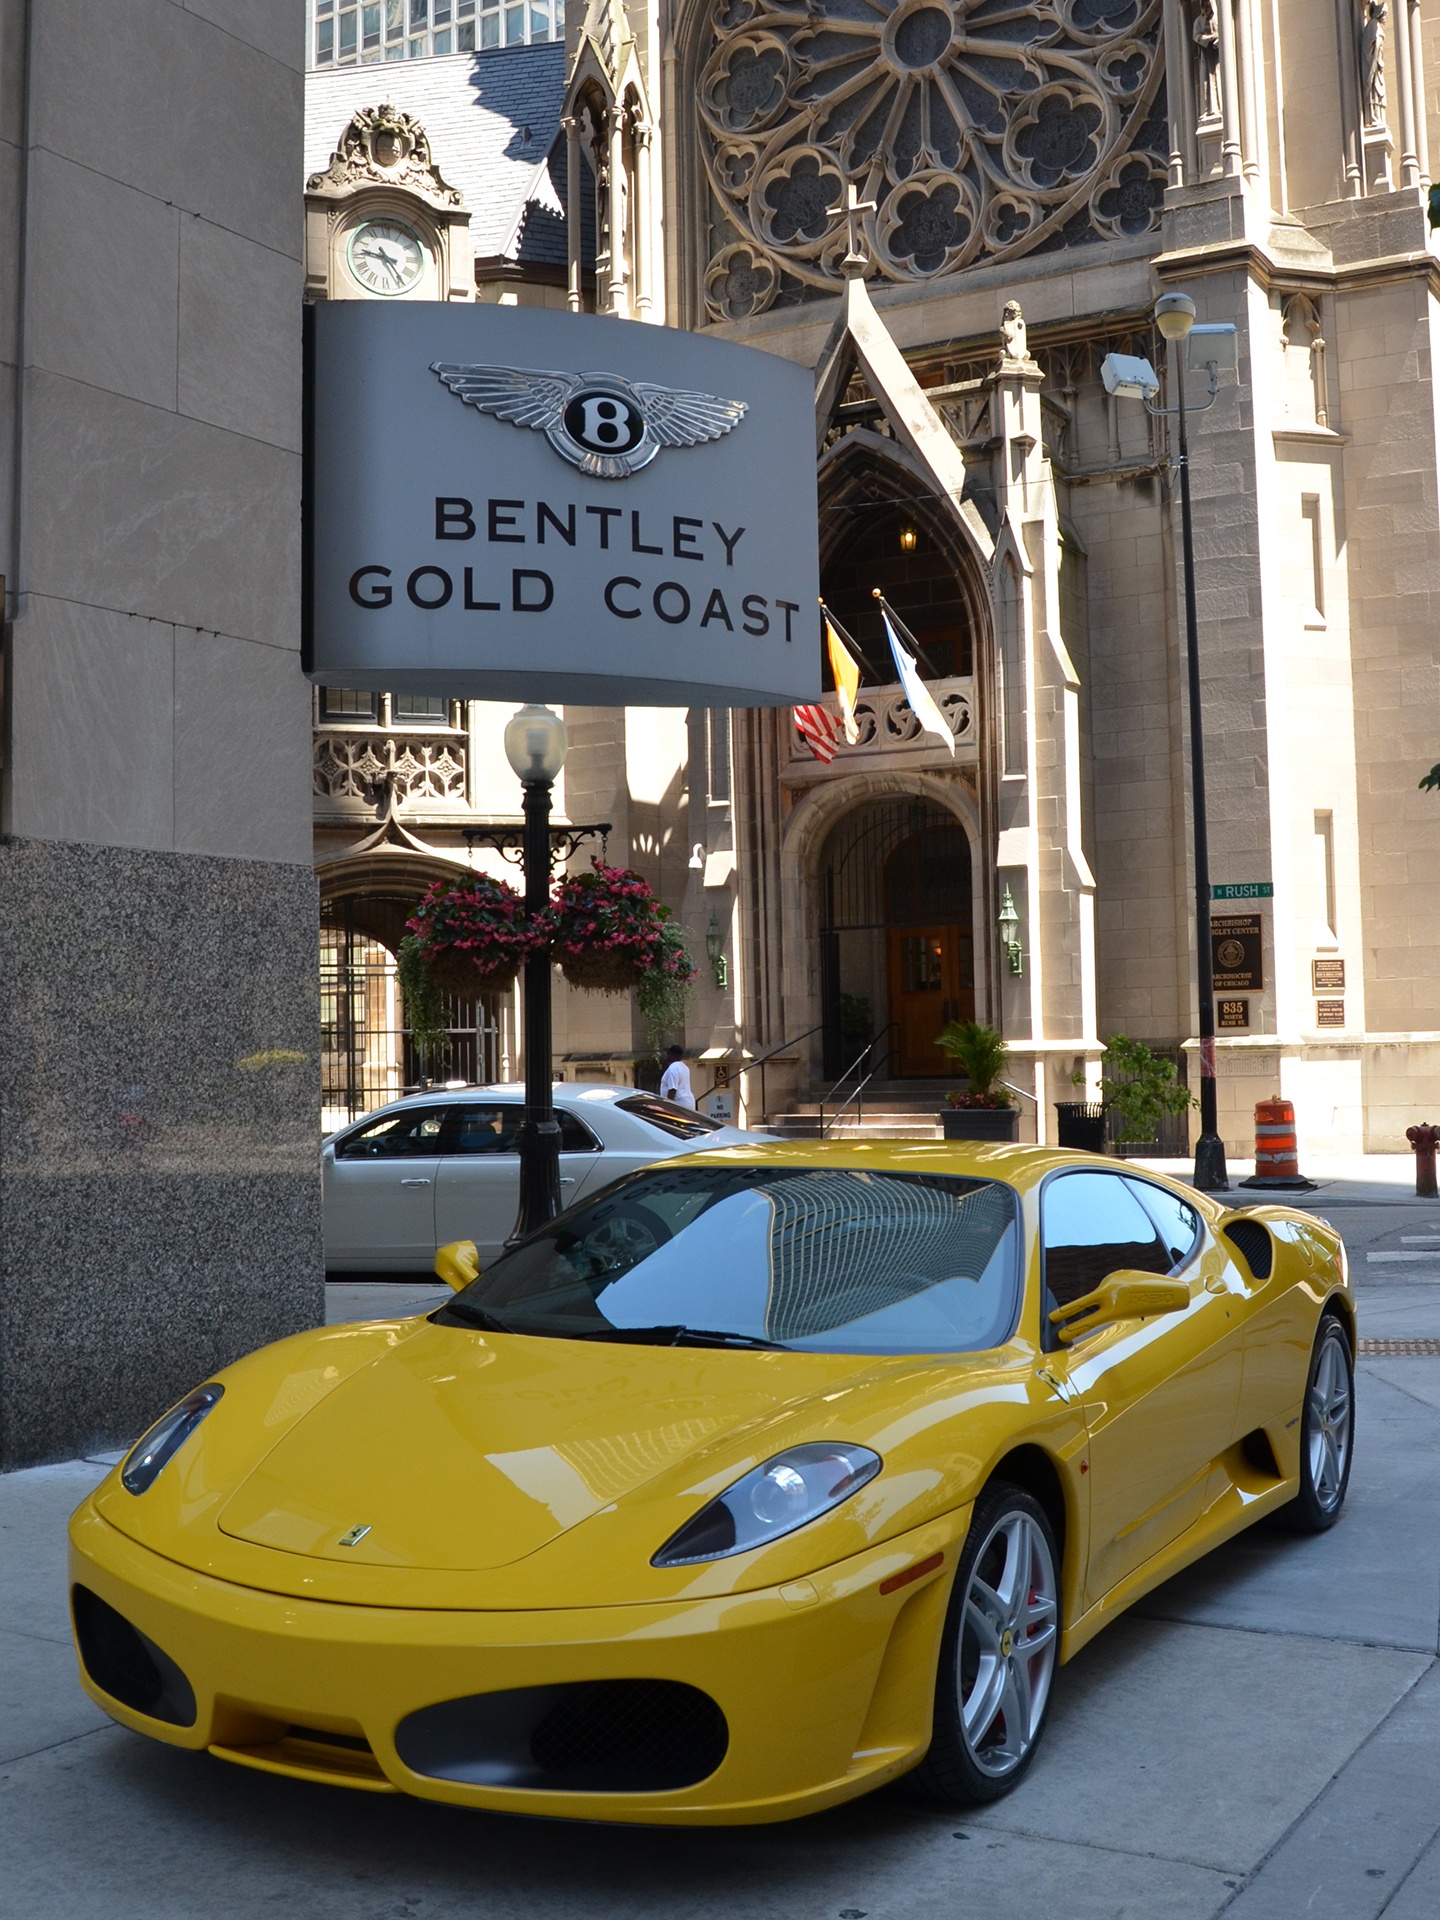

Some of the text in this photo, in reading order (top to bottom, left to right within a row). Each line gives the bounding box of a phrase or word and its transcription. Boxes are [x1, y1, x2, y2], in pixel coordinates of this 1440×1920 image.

[435, 496, 746, 566] BENTLEY
[348, 564, 800, 643] GOLD COAST
[1226, 885, 1259, 897] RUSH
[1262, 886, 1271, 894] ST
[1210, 918, 1252, 927] ARCHBISHOP
[1232, 926, 1259, 935] CENTER
[1212, 972, 1252, 980] ARCHDIOCESE
[1223, 979, 1250, 987] CHICAGO
[1223, 1002, 1243, 1014] 835
